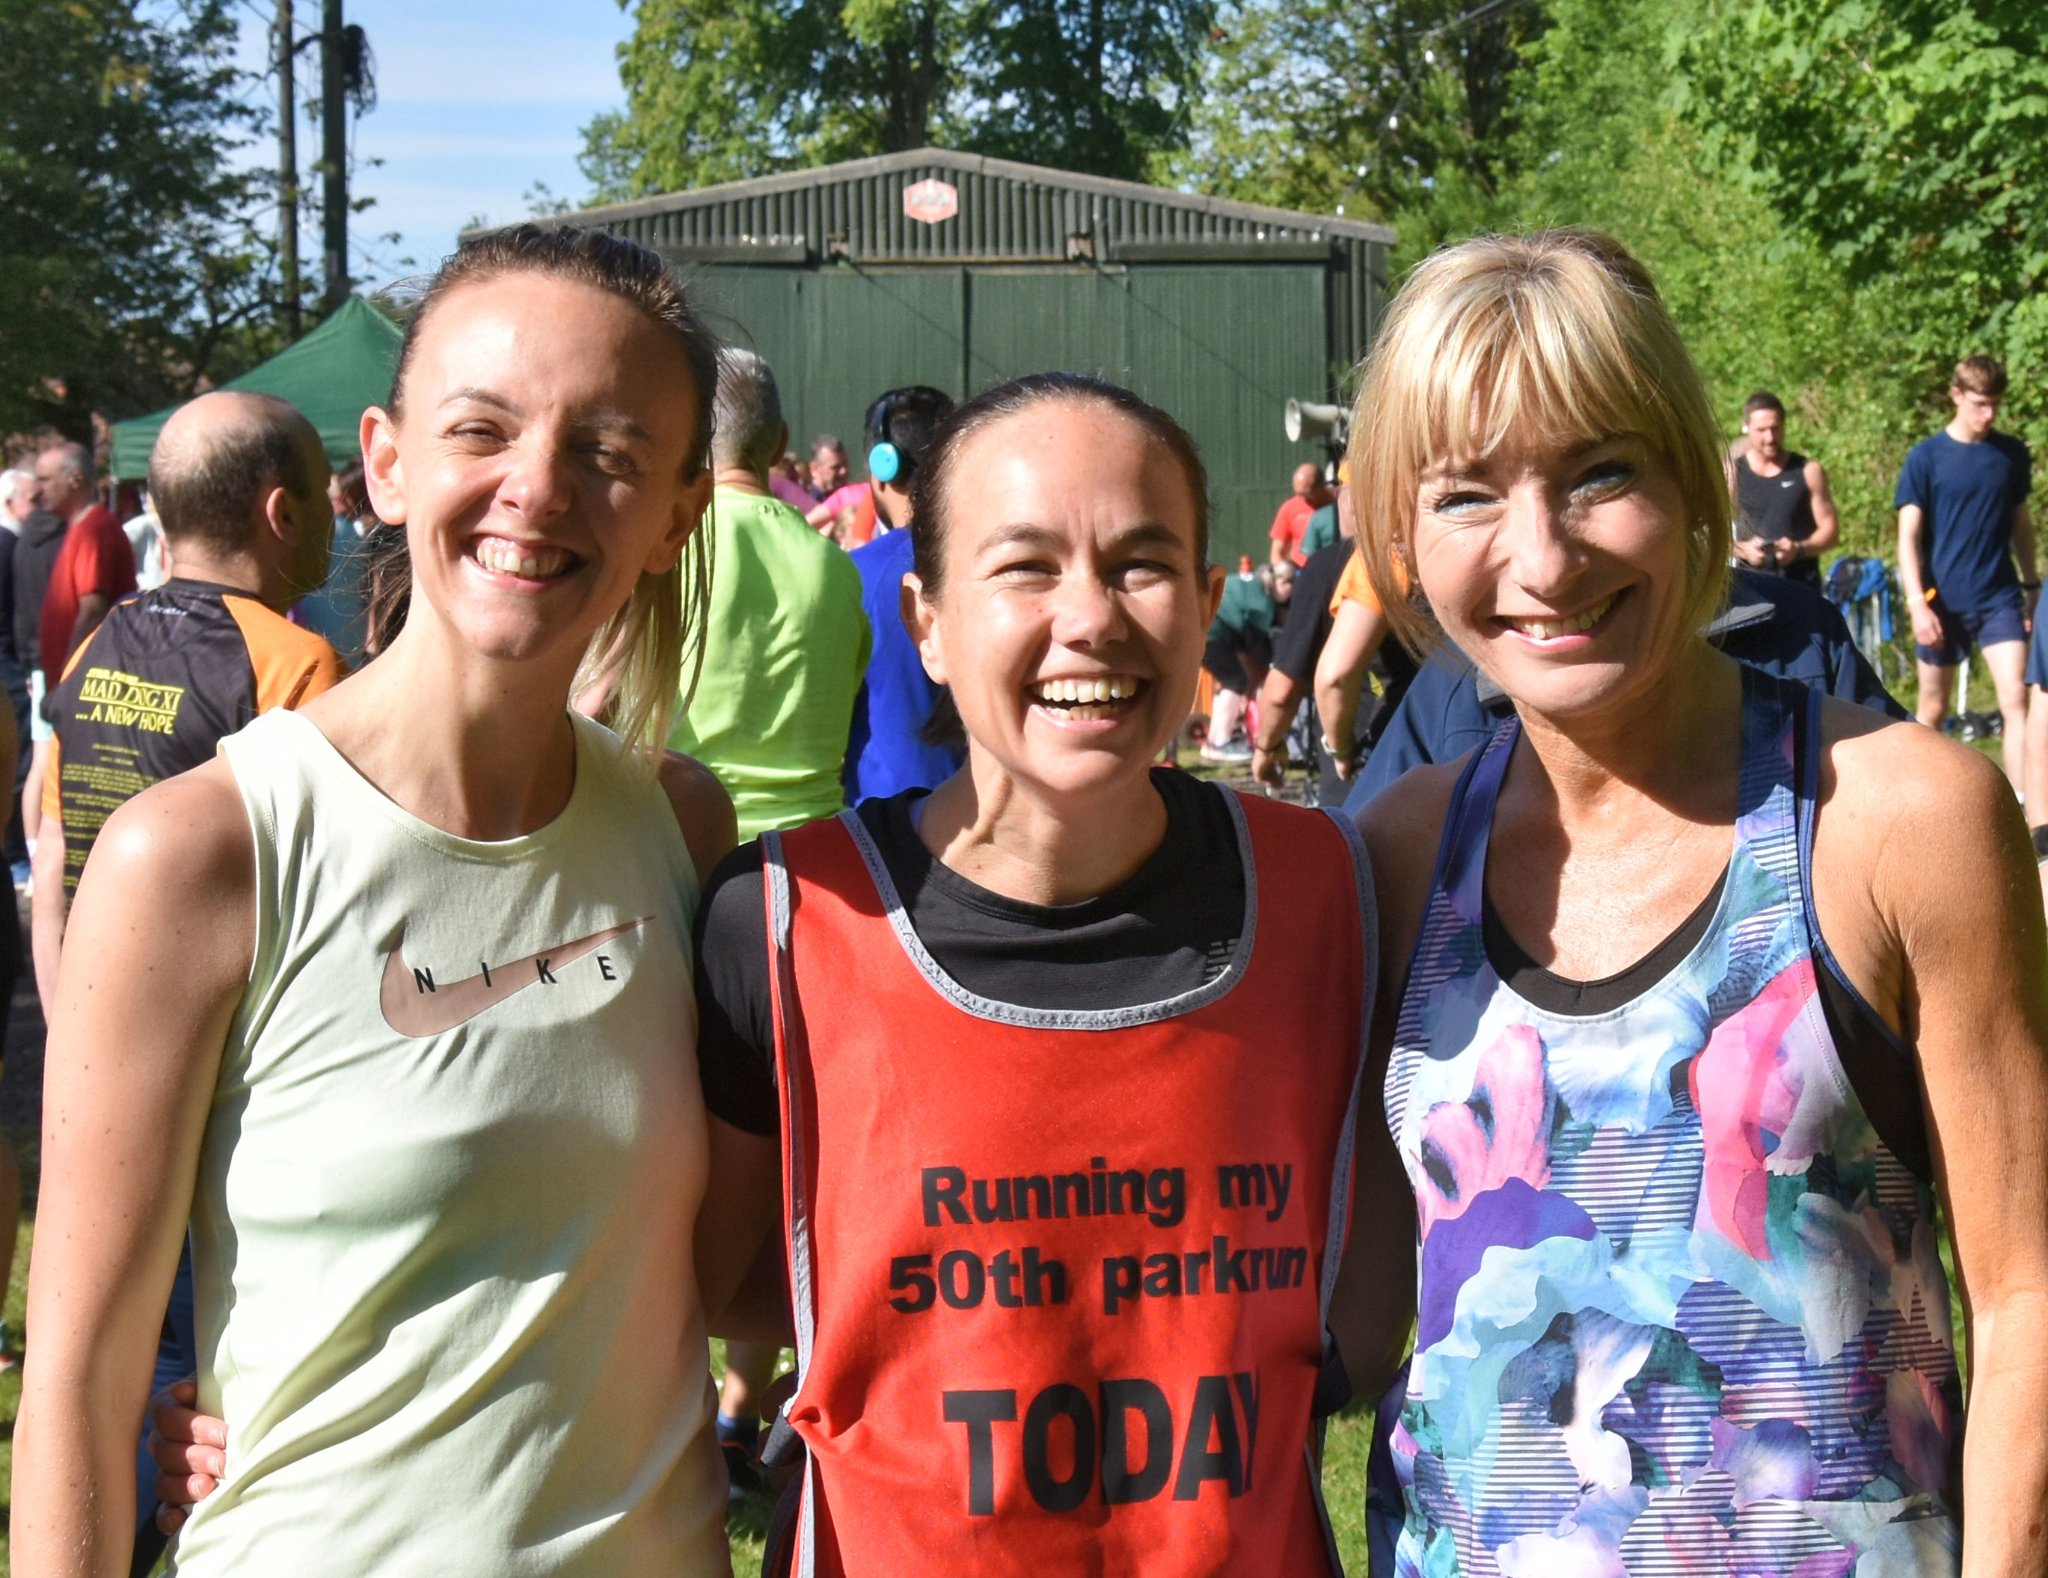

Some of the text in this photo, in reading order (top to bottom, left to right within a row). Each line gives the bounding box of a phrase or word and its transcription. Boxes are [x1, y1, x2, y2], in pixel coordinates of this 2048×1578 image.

[80, 678, 122, 700] MAD
[123, 686, 161, 708] DOG
[90, 704, 102, 721] A
[104, 704, 140, 726] NEW
[138, 711, 174, 735] HOPE
[413, 956, 617, 994] NIKE
[921, 1156, 1292, 1228] Running my
[889, 1236, 1308, 1316] 50th parkrun
[942, 1370, 1260, 1516] TODAY
